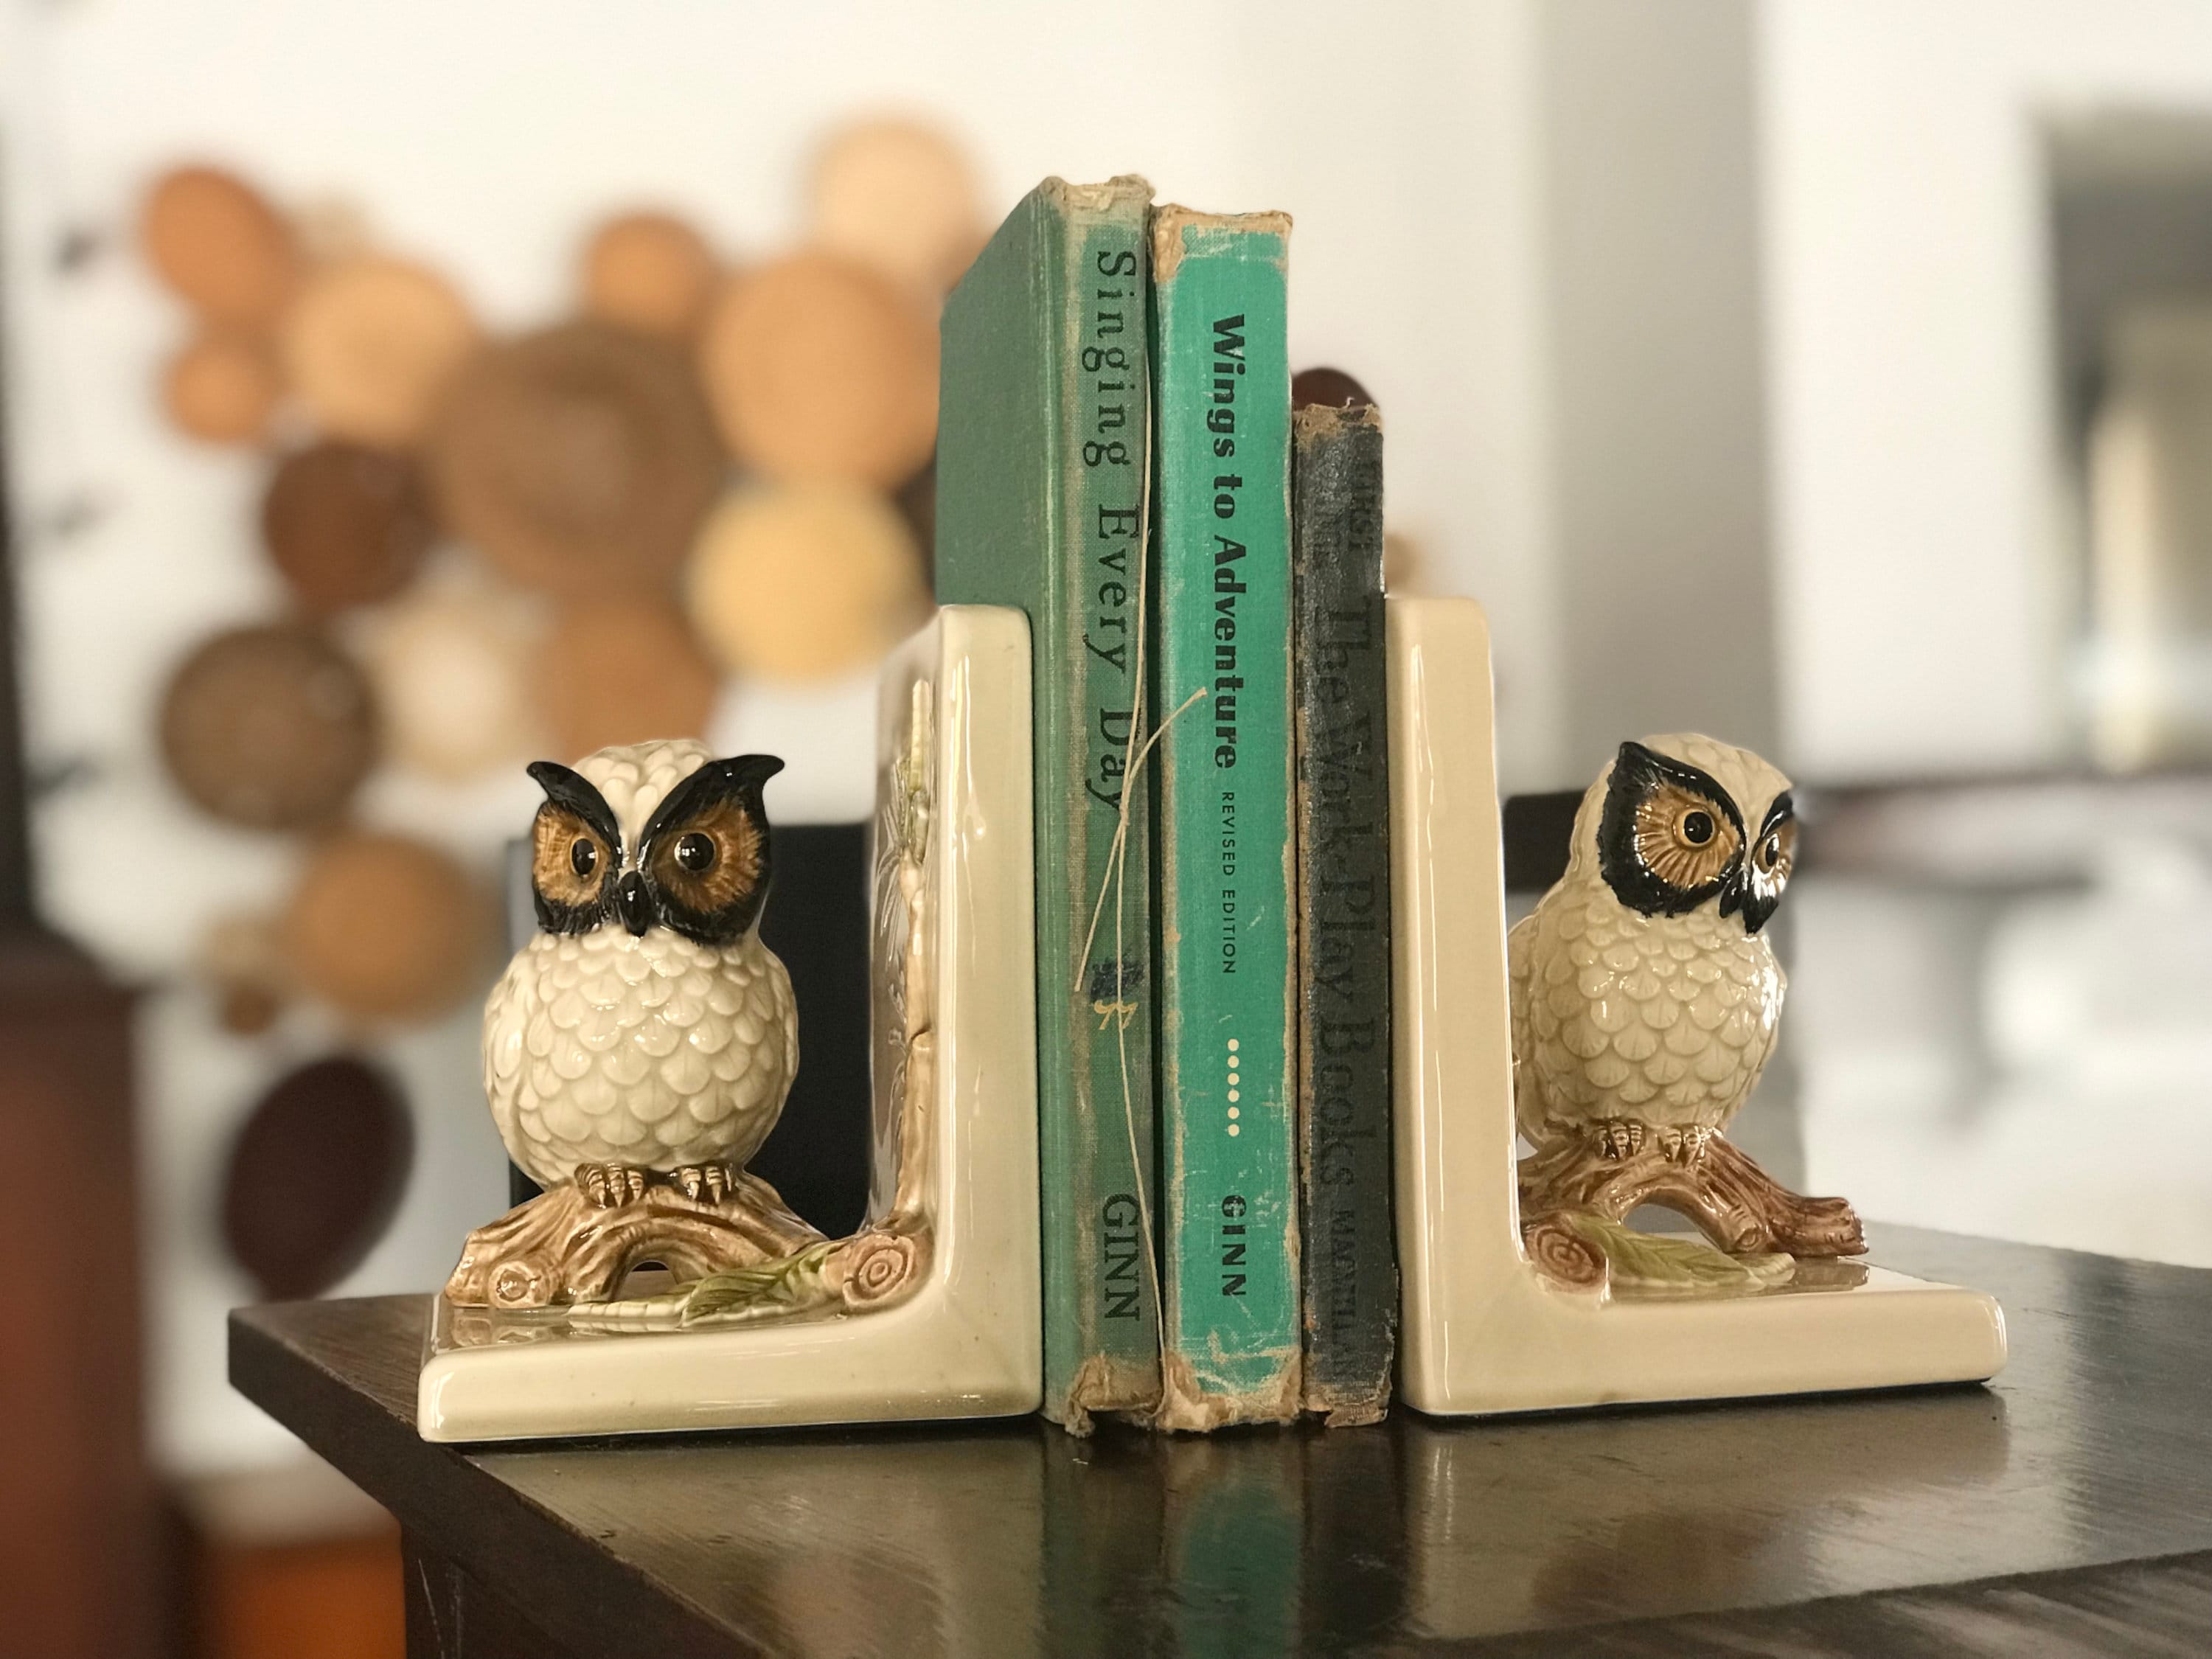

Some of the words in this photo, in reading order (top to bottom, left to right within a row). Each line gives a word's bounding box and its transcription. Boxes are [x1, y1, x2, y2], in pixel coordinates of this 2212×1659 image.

[1081, 250, 1137, 467] Singing
[1206, 313, 1246, 458] Wings
[1213, 473, 1242, 519] to
[1082, 503, 1141, 674] Every
[1214, 535, 1248, 769] Adventure
[1315, 594, 1373, 703] The
[1085, 707, 1141, 812] Day
[1222, 791, 1236, 876] REVISED
[1222, 889, 1237, 974] EDITION
[1318, 1015, 1378, 1186] Books
[1102, 1193, 1141, 1322] GINN
[1221, 1194, 1247, 1296] GINN
